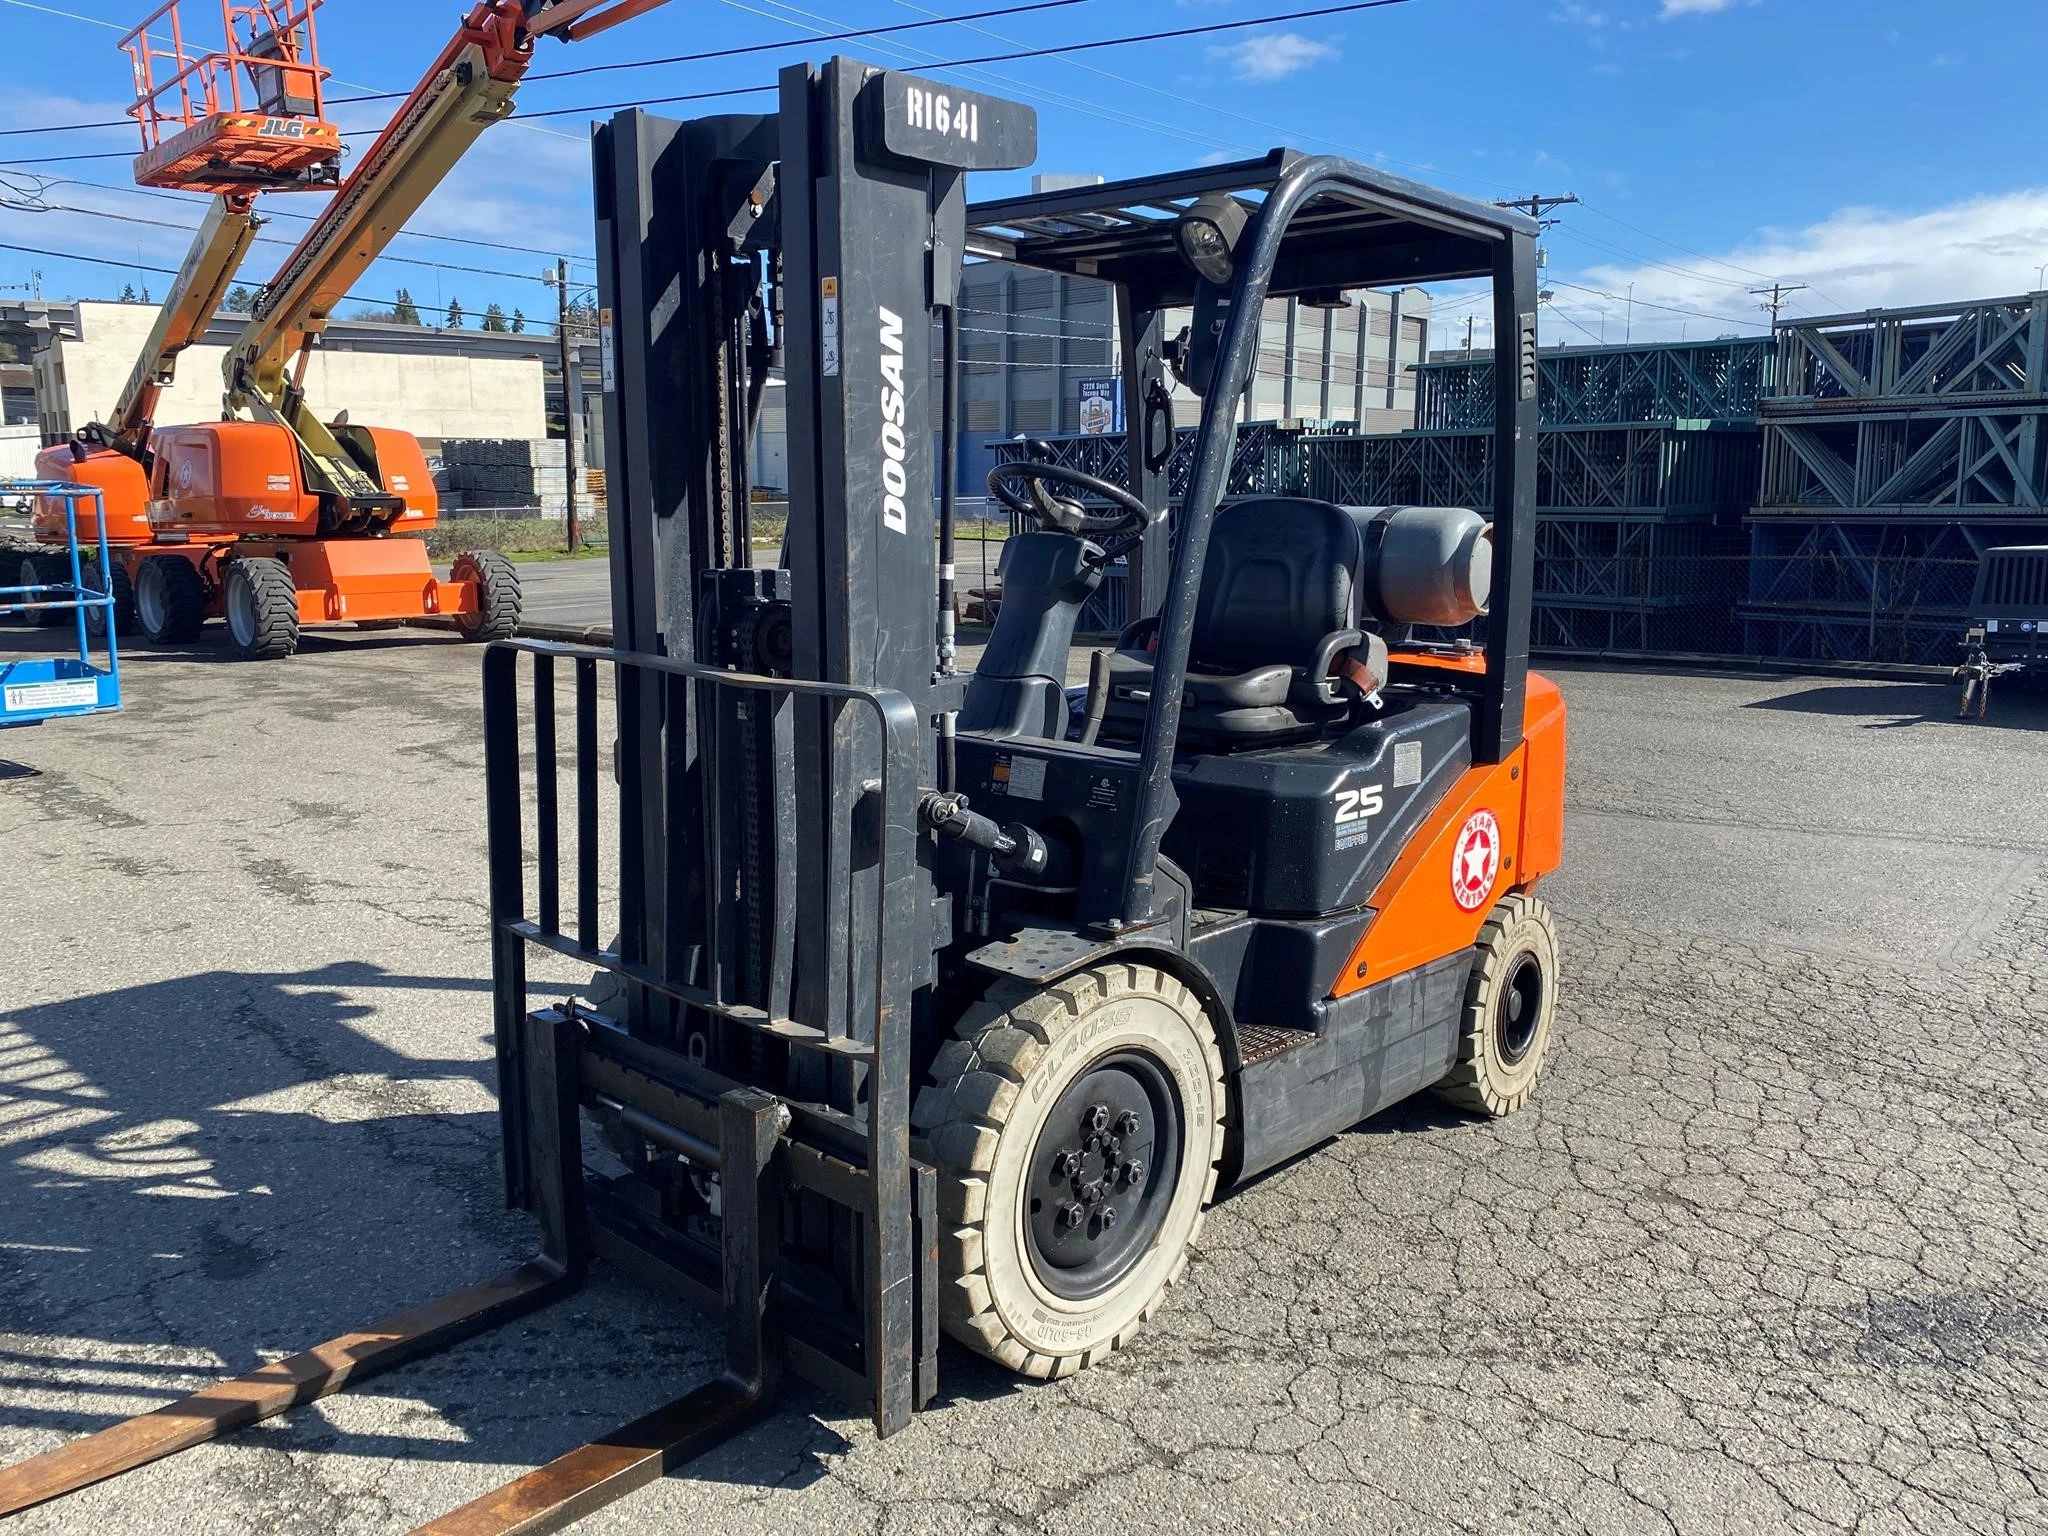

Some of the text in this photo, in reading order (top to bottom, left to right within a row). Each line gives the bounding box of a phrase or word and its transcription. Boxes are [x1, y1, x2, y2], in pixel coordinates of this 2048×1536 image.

[258, 118, 304, 138] JLG
[907, 87, 978, 142] R1641
[879, 305, 907, 535] DOOSAN
[1335, 784, 1383, 824] 25
[1465, 815, 1493, 836] STAR
[1455, 871, 1494, 906] RENTALS
